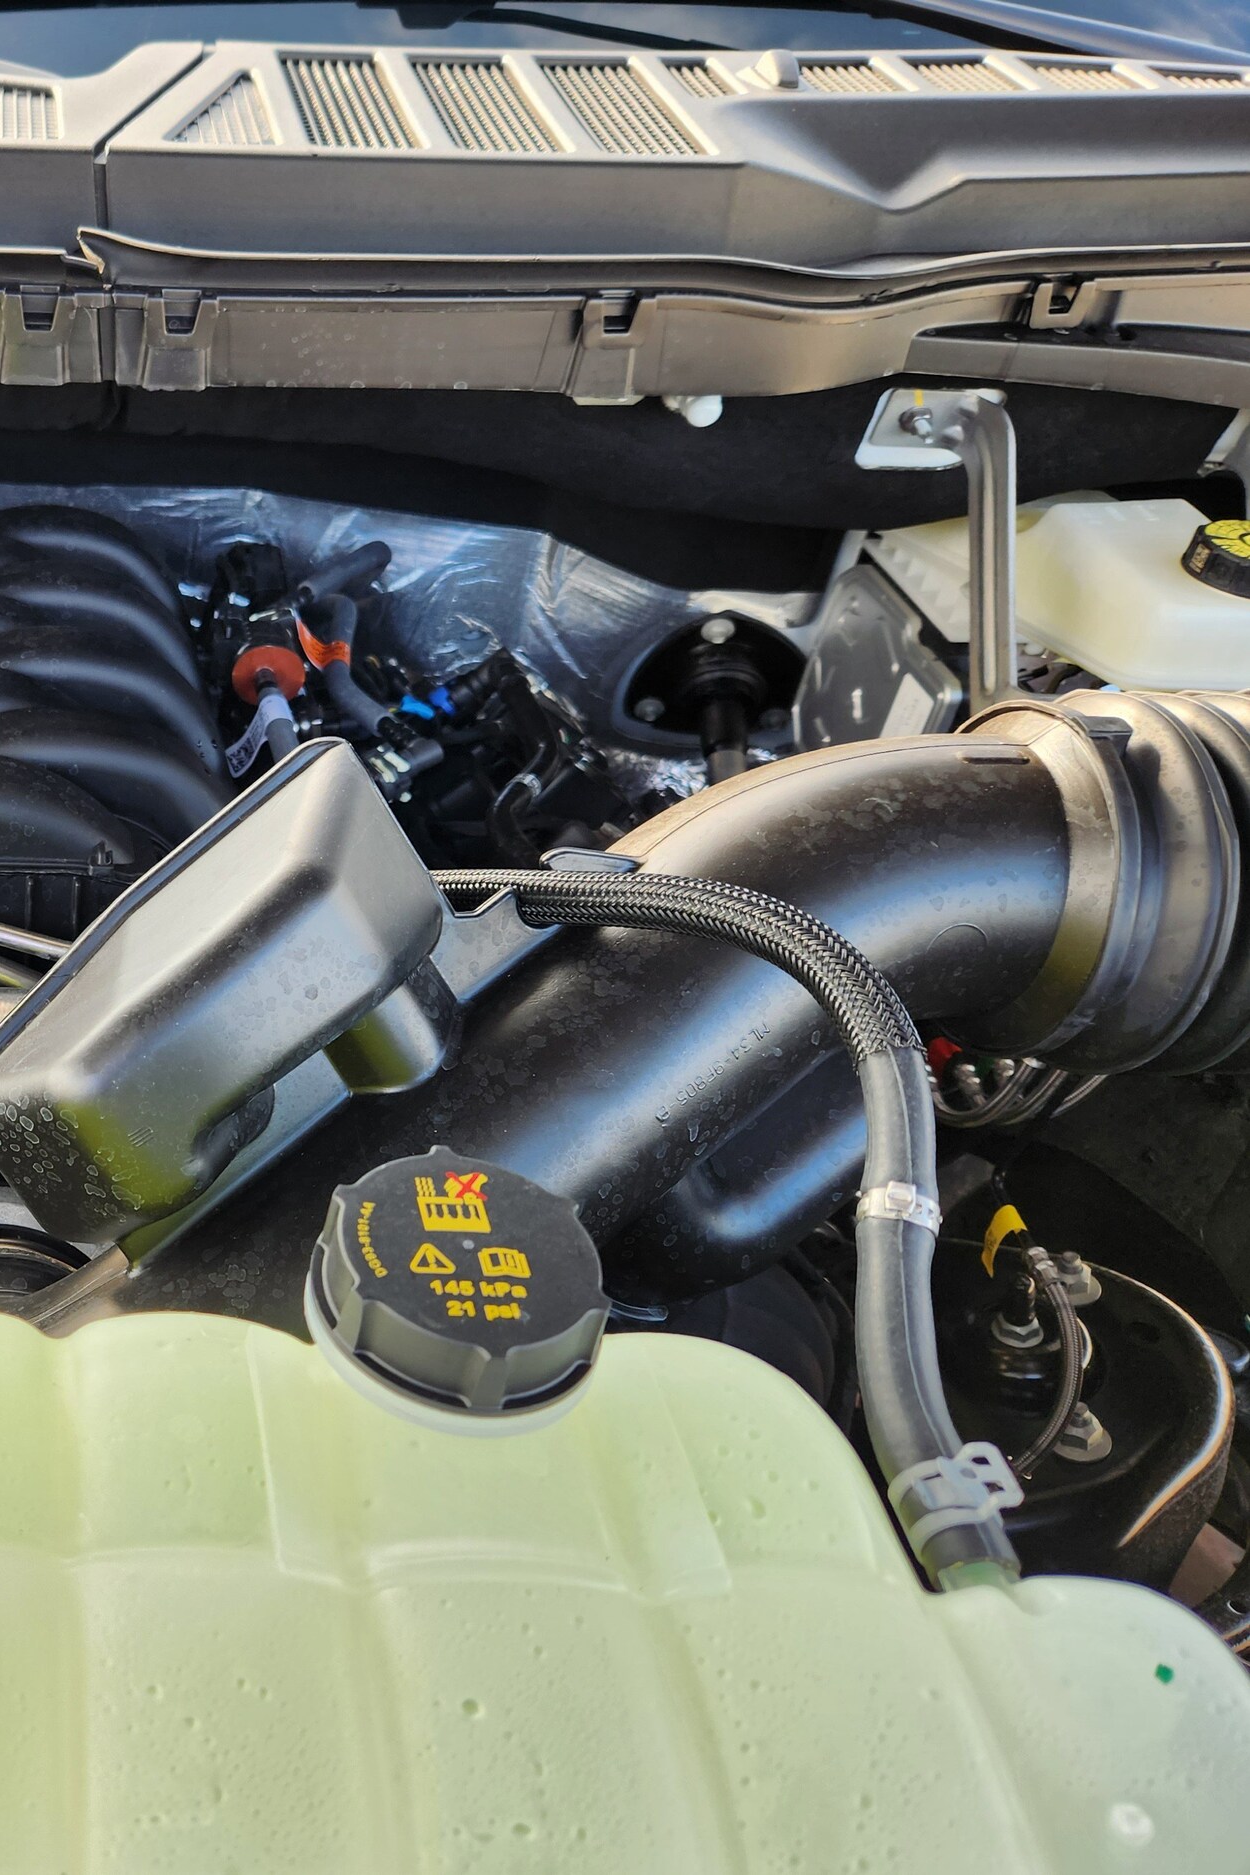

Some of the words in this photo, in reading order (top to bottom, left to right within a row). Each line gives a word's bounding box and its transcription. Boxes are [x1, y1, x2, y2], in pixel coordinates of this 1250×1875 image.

[429, 1279, 475, 1297] 145
[479, 1281, 527, 1298] kPa
[446, 1300, 476, 1317] 21
[483, 1302, 521, 1322] psi
